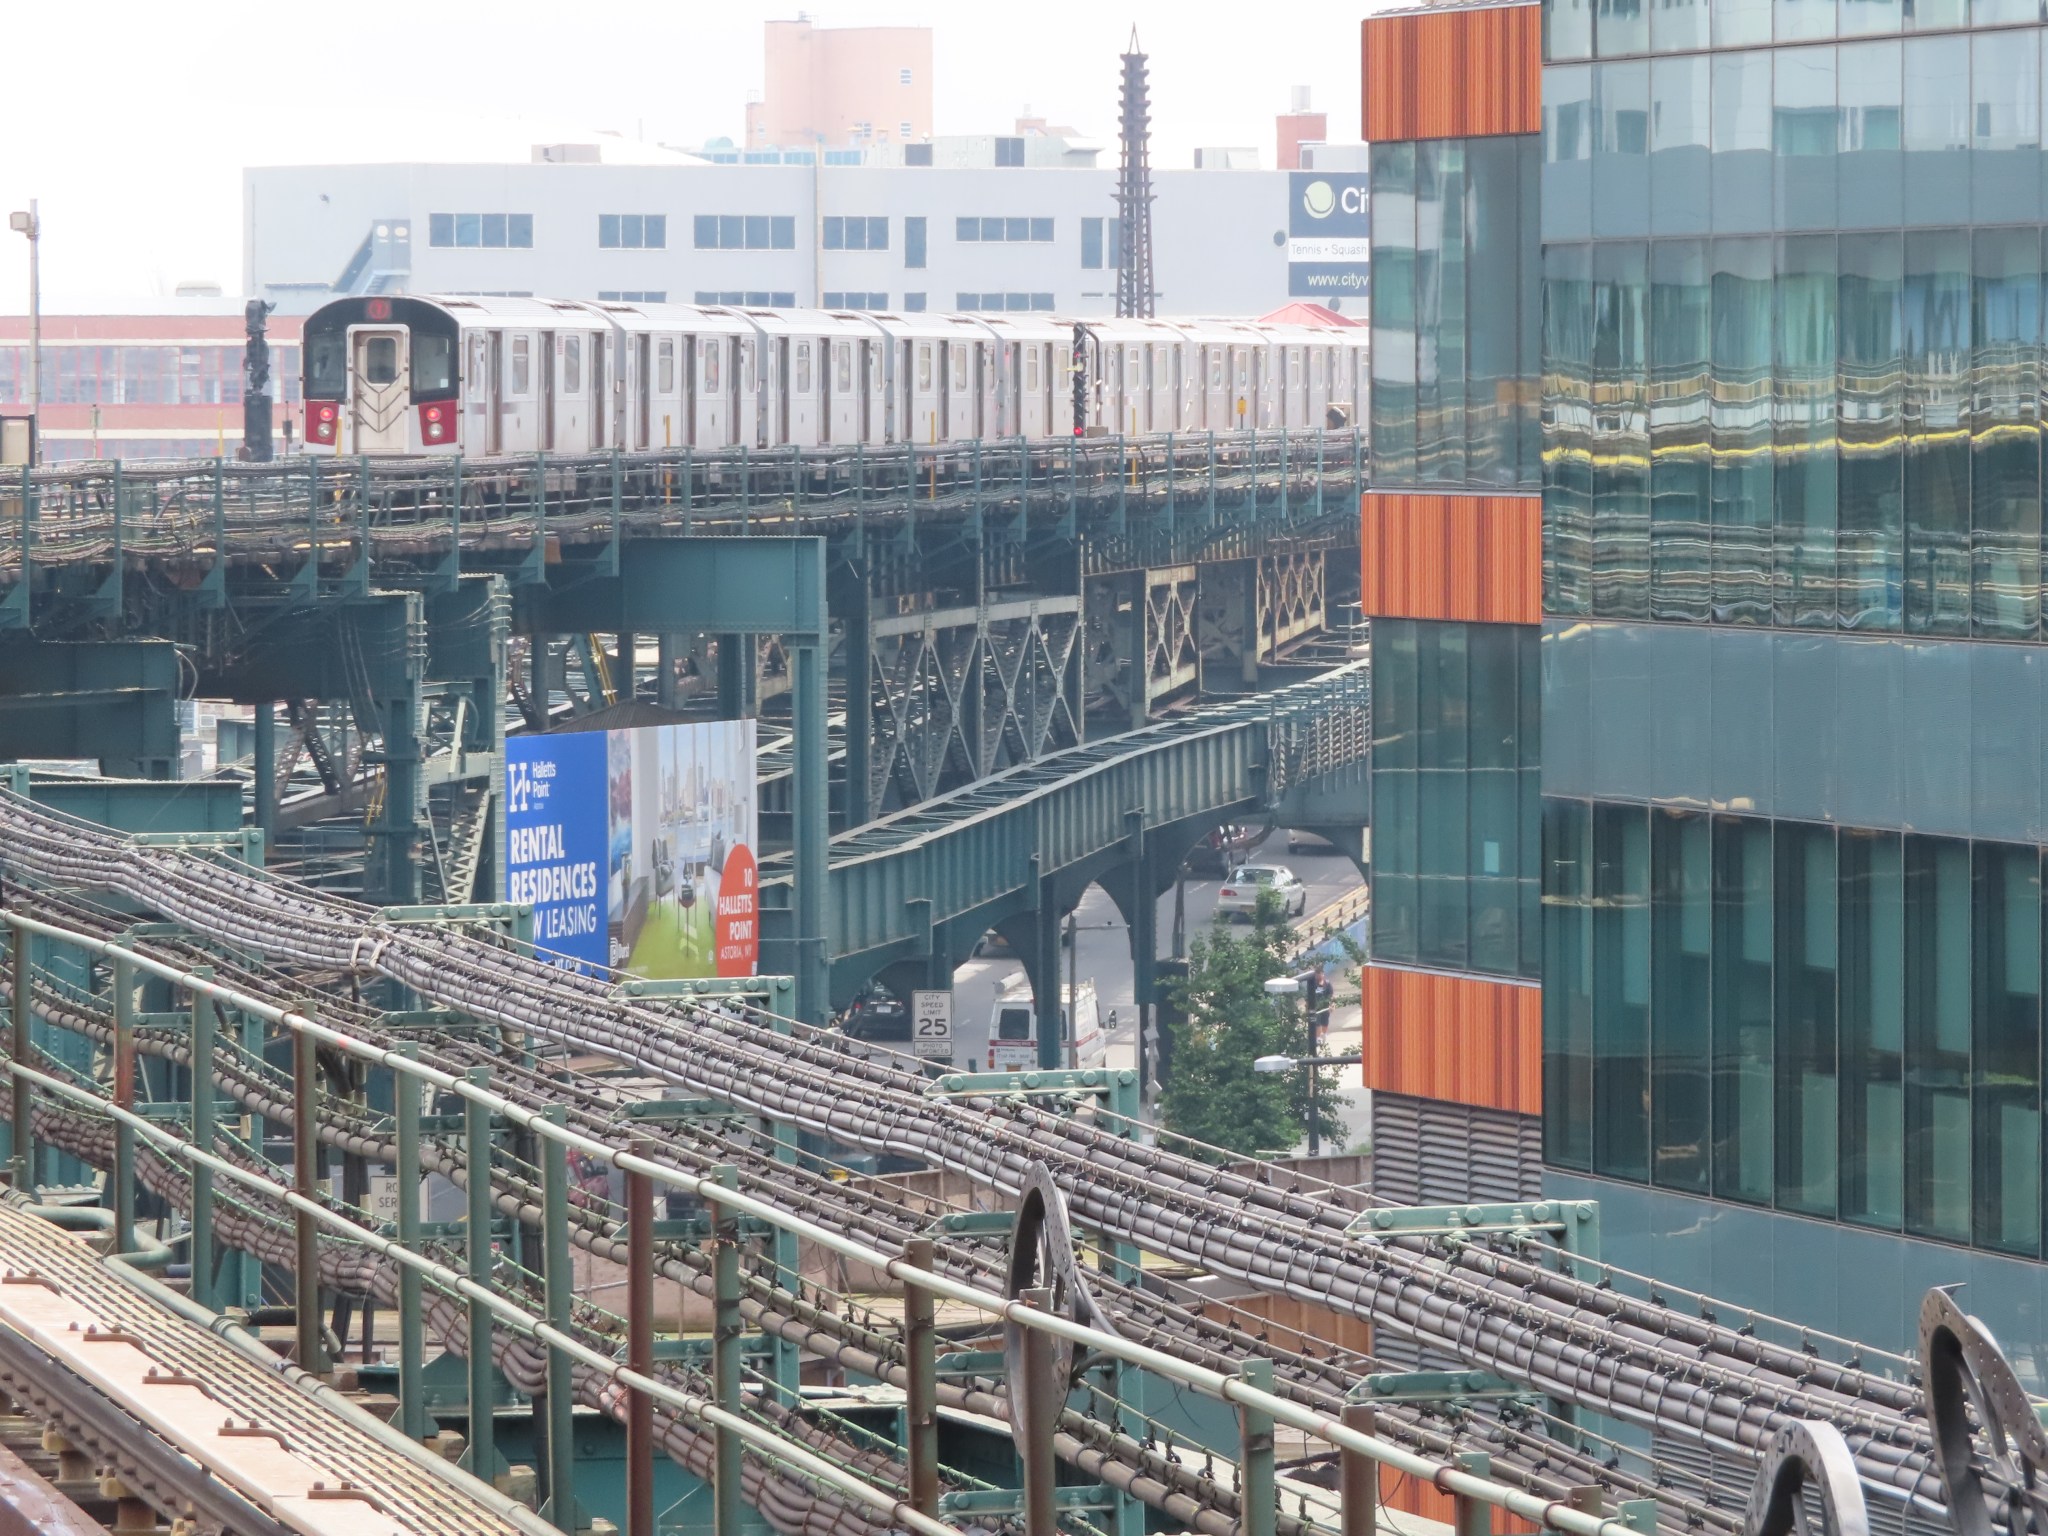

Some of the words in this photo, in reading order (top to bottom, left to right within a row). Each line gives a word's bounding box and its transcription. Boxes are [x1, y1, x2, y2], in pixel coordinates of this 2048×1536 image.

[1291, 244, 1322, 255] Tennis
[1331, 243, 1367, 257] Squash
[1308, 272, 1369, 289] www.cityv
[532, 761, 557, 779] Halletts
[533, 780, 551, 798] Point
[511, 824, 565, 865] RENTAL
[511, 862, 597, 904] RESIDENCES
[744, 868, 753, 887] 10
[719, 894, 753, 916] HALLETTS
[547, 903, 597, 939] LEASING
[729, 920, 753, 941] POINT
[918, 1017, 948, 1036] 25
[379, 1196, 398, 1208] SER
